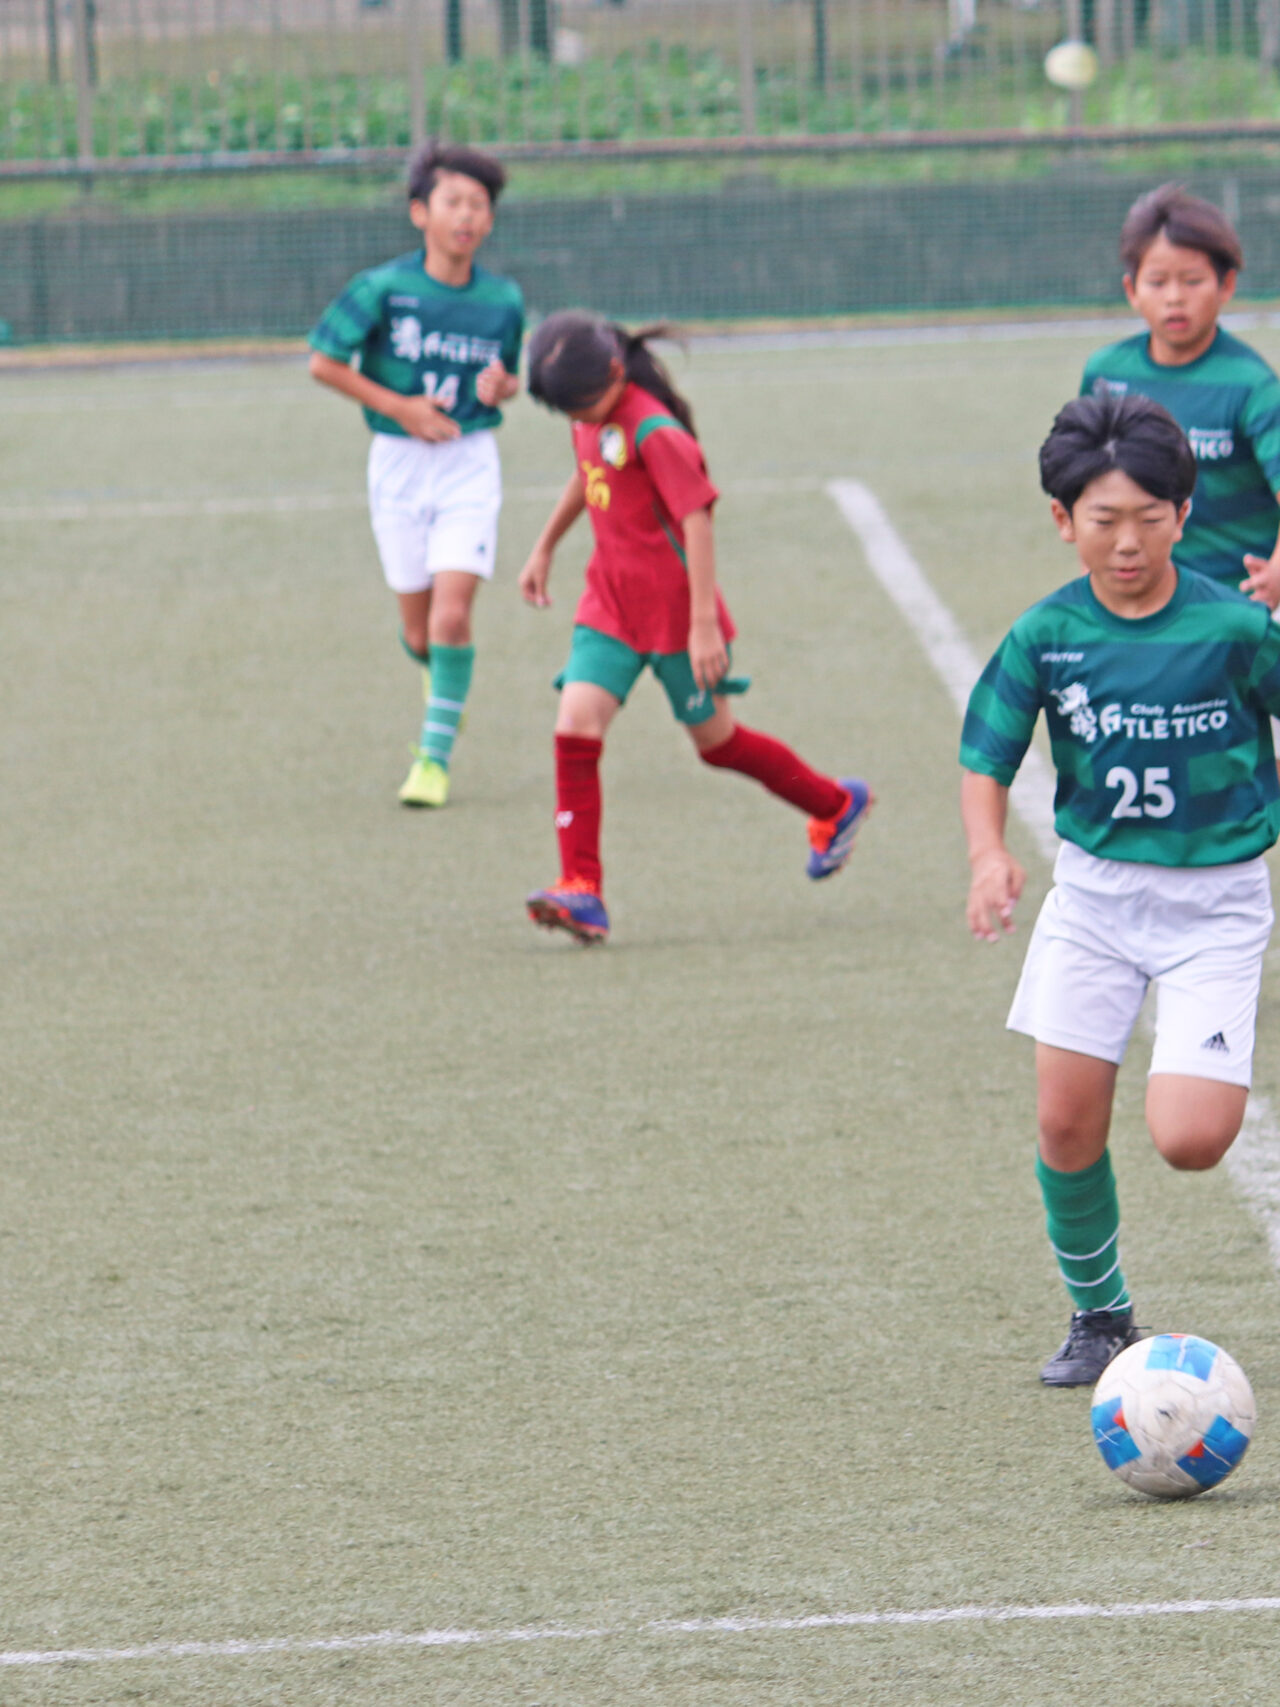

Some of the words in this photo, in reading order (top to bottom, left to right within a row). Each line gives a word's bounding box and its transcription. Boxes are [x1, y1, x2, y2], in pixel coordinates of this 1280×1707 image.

[1188, 439, 1234, 460] TICO
[1100, 703, 1228, 739] ATLETICO
[1105, 766, 1176, 819] 25
